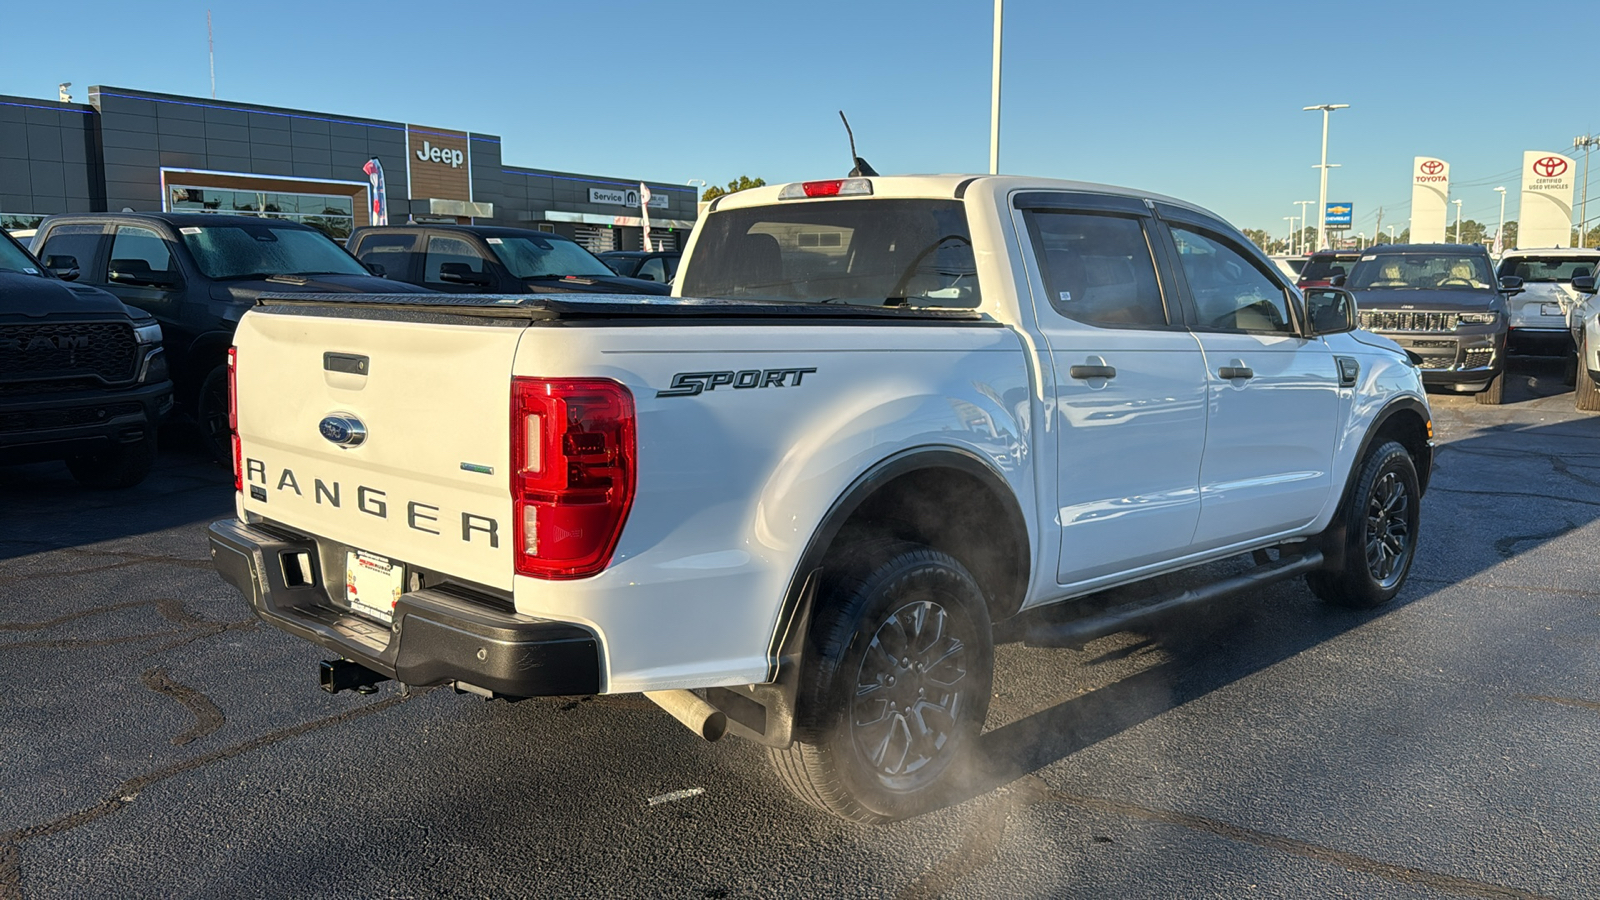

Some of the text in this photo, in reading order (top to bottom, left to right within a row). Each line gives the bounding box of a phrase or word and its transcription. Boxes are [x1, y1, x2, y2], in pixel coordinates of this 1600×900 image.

[416, 141, 464, 168] Jeep
[593, 191, 622, 202] Service
[655, 367, 817, 398] SPORT
[246, 457, 499, 548] RANGER
